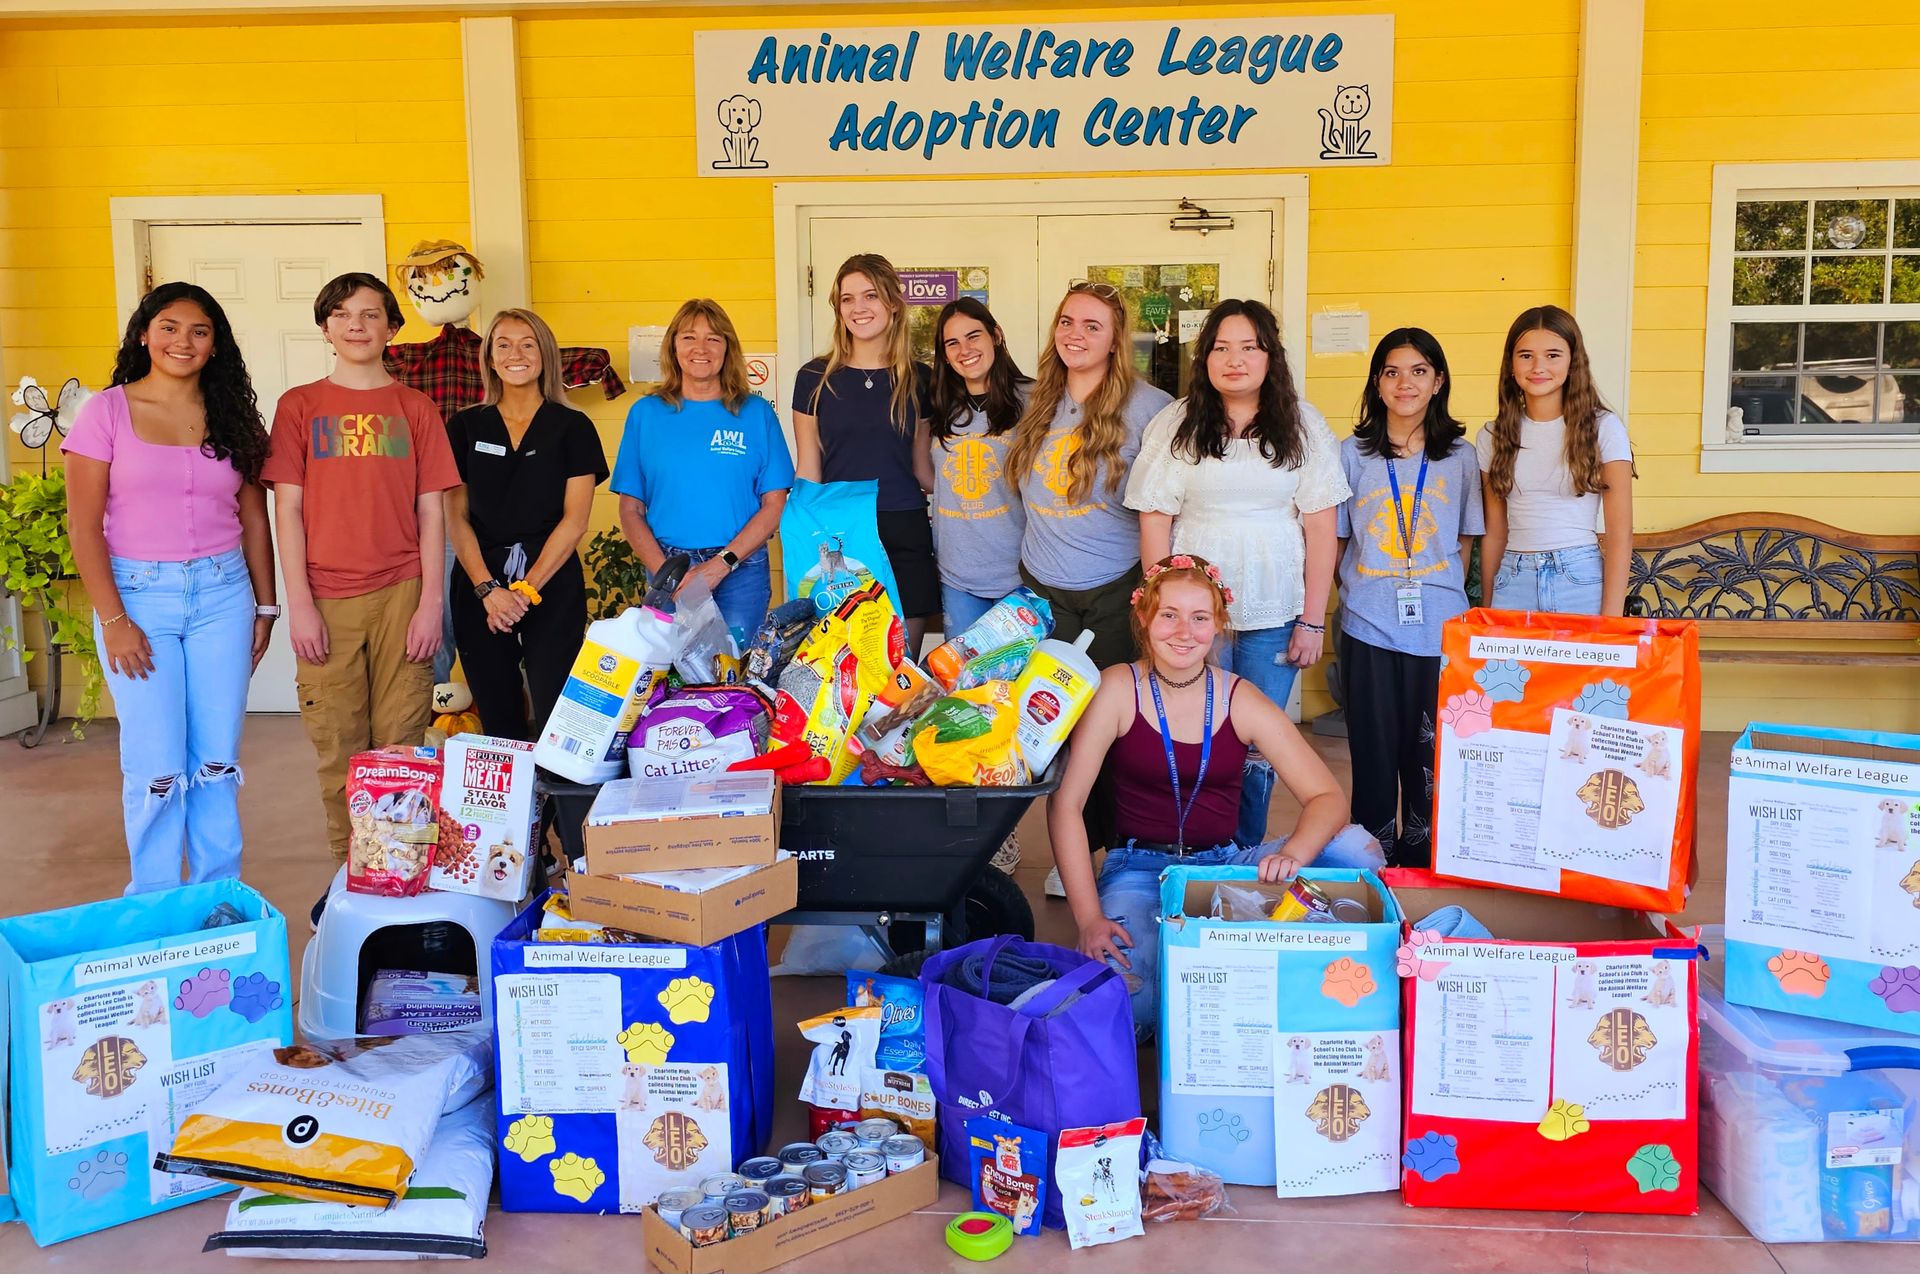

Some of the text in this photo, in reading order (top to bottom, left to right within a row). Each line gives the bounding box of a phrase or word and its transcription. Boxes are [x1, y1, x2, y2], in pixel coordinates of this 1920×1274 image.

[748, 26, 1342, 84] Animal Welfare League
[828, 96, 1257, 160] Adoption Center
[908, 280, 947, 296] love
[710, 429, 746, 449] AWL
[966, 443, 976, 492] LEO
[1478, 642, 1620, 663] Animal Welfare League
[582, 670, 620, 690] SCOOPABLE
[658, 724, 703, 737] FOREVER
[657, 739, 678, 750] PALS
[1592, 737, 1618, 746] collecting
[477, 752, 511, 763] PURINA
[1458, 748, 1504, 762] WISH LIST
[1621, 749, 1642, 757] Welfare
[466, 759, 503, 771] MOIST
[644, 756, 718, 778] Cat Litter
[1746, 756, 1791, 772] Animal
[1796, 762, 1852, 778] Welfare
[1857, 768, 1909, 784] League
[355, 766, 436, 783] DreamBone
[464, 768, 511, 792] MEATY
[464, 796, 506, 810] FLAVOR
[468, 790, 505, 801] STEAK
[1602, 772, 1619, 822] LEO
[460, 806, 472, 817] 12
[1749, 804, 1803, 821] WISH LIST
[790, 850, 834, 861] CARTS
[1209, 930, 1351, 946] Animal Welfare League
[84, 939, 240, 976] Animal Welfare League
[532, 951, 670, 966] Animal Welfare League
[1424, 945, 1576, 963] Animal Welfare League
[1181, 972, 1228, 984] WISH LIST
[509, 984, 559, 998] WISH LIST
[1437, 980, 1487, 994] WISH LIST
[77, 1008, 106, 1018] collecting
[89, 1014, 110, 1022] Animal
[111, 1010, 134, 1018] Welfare
[880, 1004, 916, 1032] 9Lives
[904, 1040, 921, 1050] Daily
[1616, 1012, 1630, 1064] LEO
[102, 1040, 117, 1090] LEO
[160, 1062, 216, 1087] WISH LIST
[260, 1072, 396, 1100] CRUNCHY DOG FOOD
[898, 1094, 931, 1112] BONES
[958, 1096, 979, 1108] DIRECT
[1333, 1087, 1345, 1135] LEO
[670, 1115, 682, 1164] LEO
[984, 1164, 1034, 1192] Chew Bones
